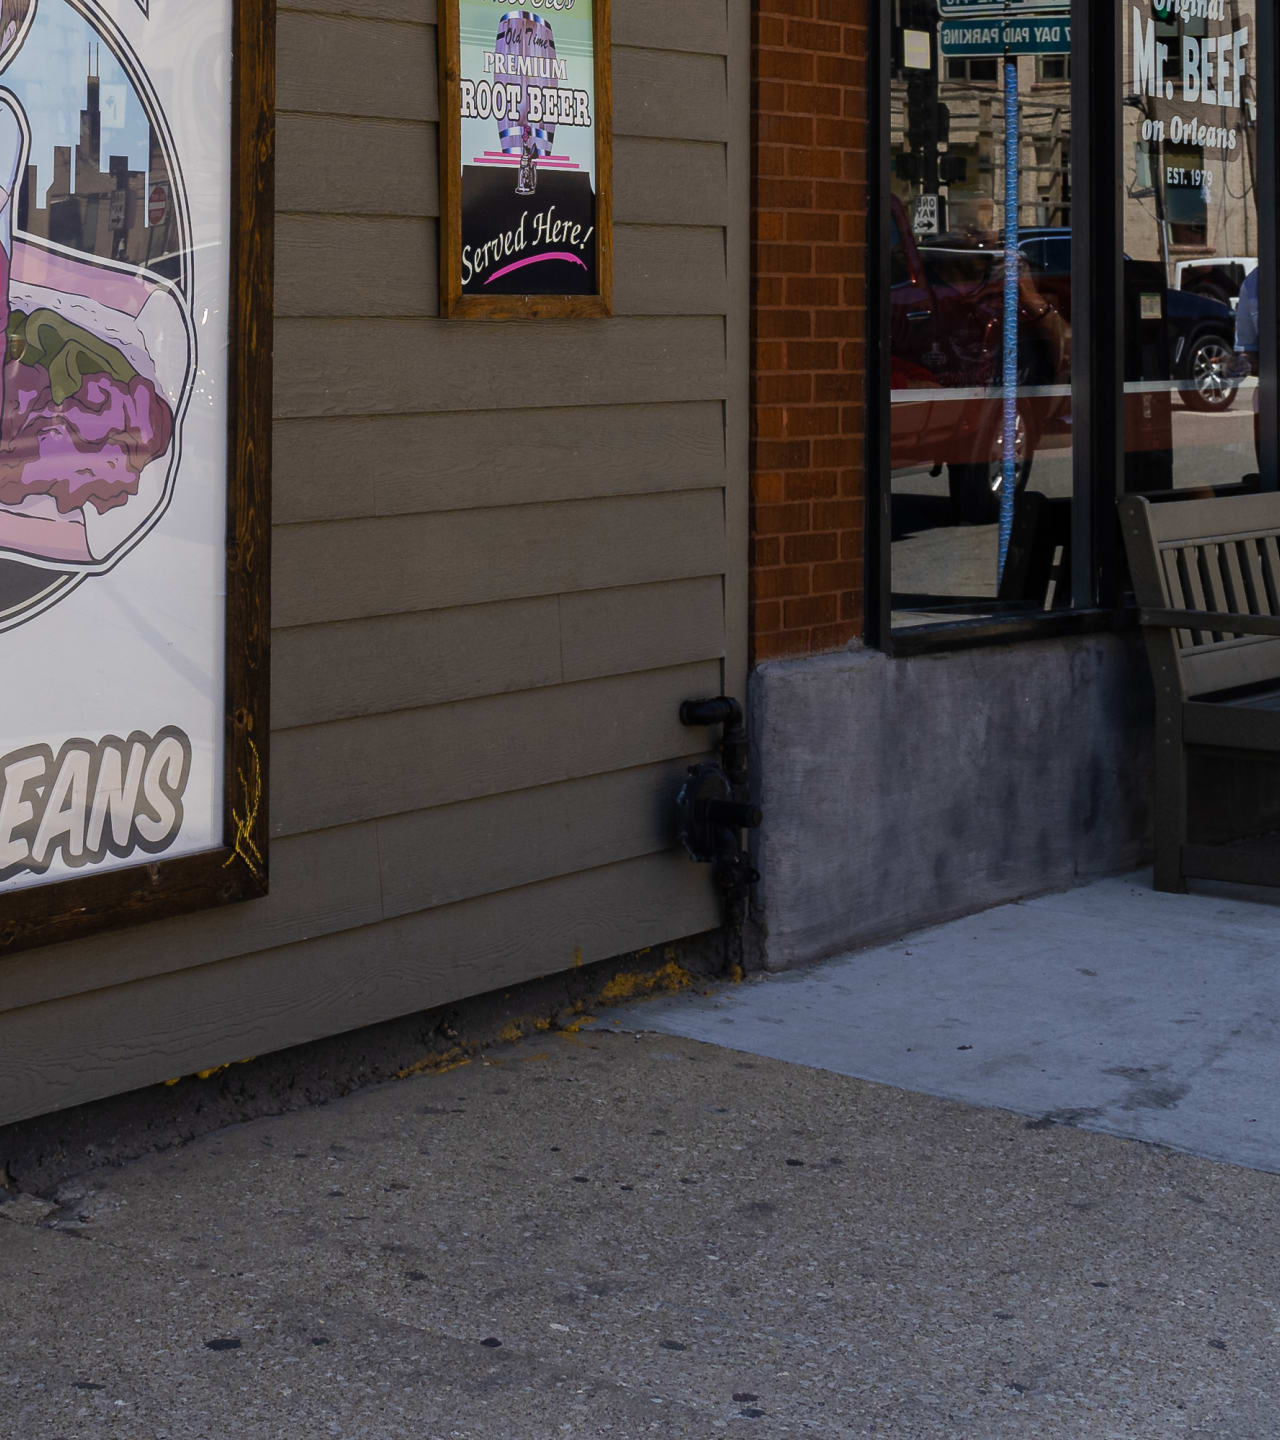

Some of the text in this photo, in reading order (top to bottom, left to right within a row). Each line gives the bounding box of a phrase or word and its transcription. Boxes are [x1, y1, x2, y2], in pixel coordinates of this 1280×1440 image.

[504, 26, 549, 51] Old Time
[482, 50, 568, 81] PREMIUM
[1132, 5, 1249, 108] Mr. BEEF
[460, 78, 592, 127] ROOT BEER
[1141, 115, 1237, 150] on Orleans
[1166, 166, 1214, 187] EST. 1979
[461, 204, 594, 285] Served Here!
